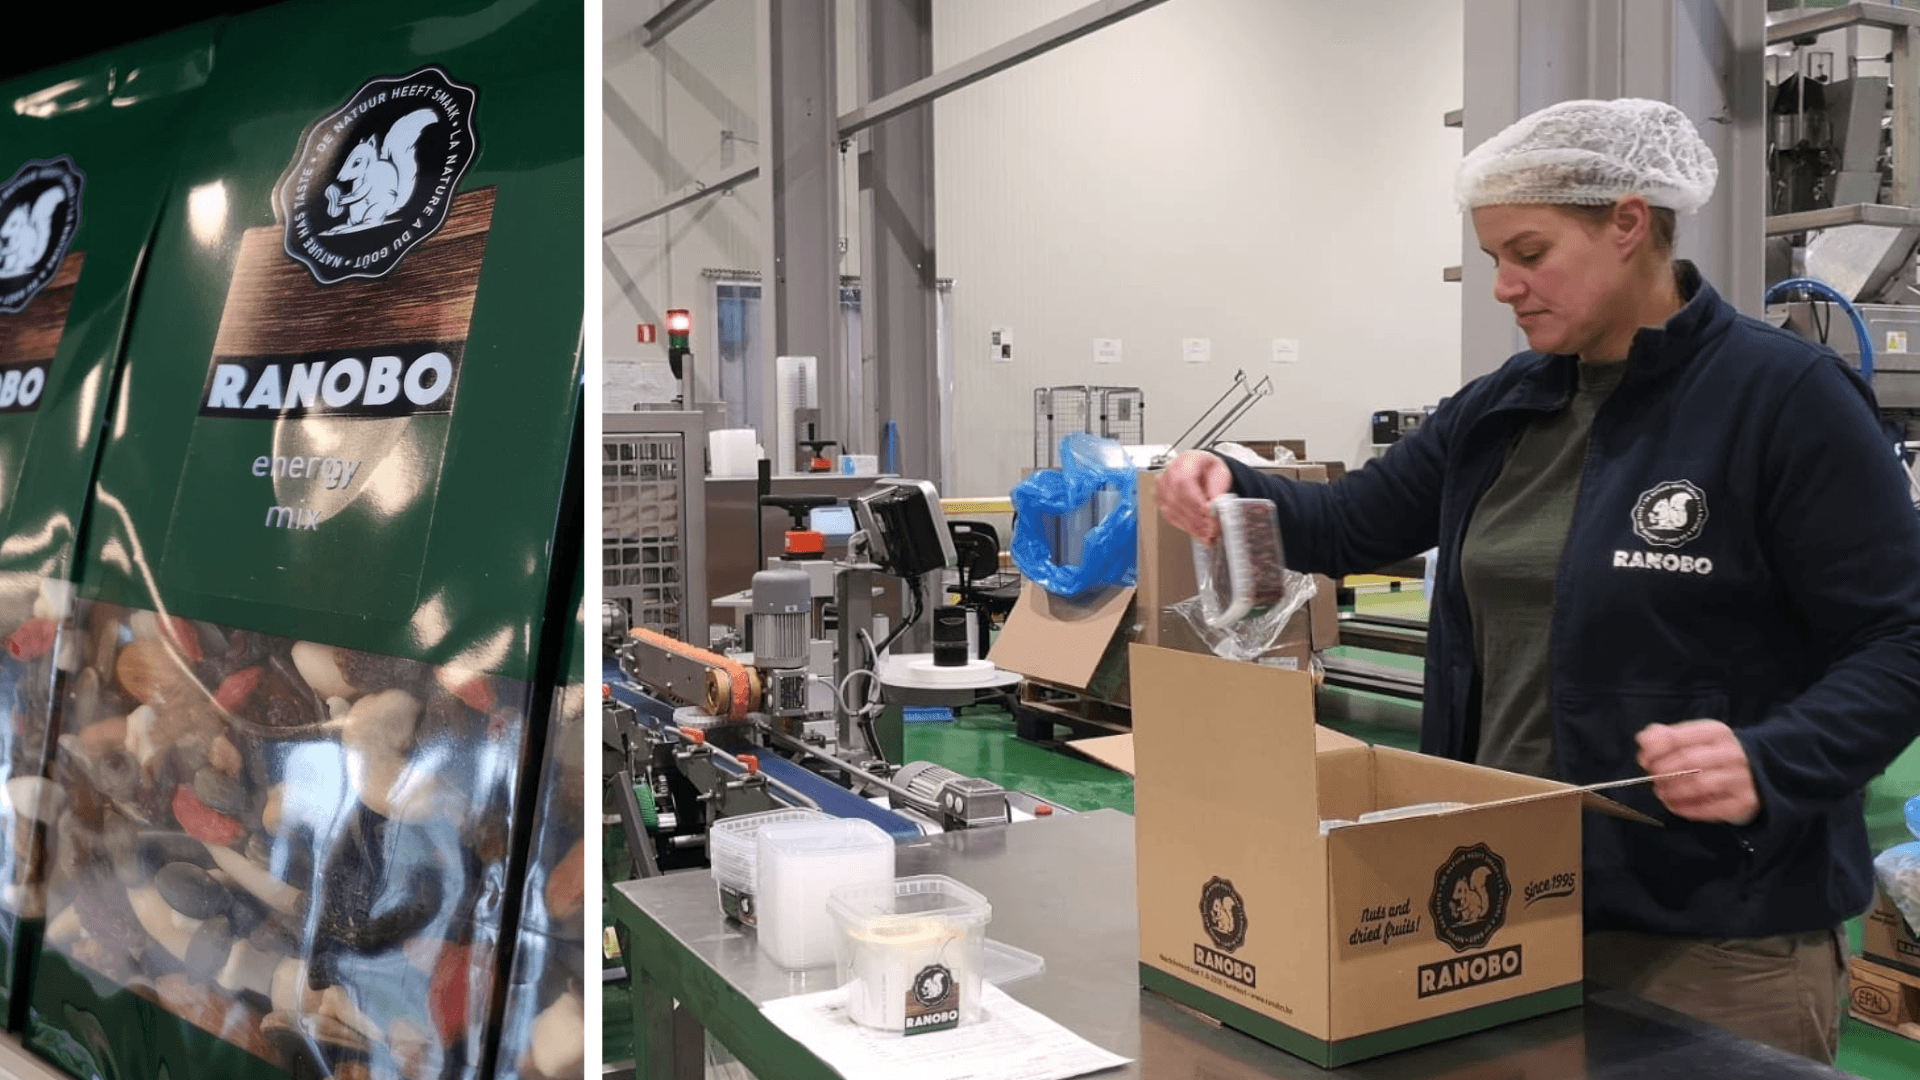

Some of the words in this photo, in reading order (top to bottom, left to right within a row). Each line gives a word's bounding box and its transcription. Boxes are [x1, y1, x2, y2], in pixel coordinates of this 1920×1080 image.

[316, 132, 334, 152] DE
[334, 93, 386, 133] NATUUR
[391, 85, 434, 100] HEEFT
[432, 89, 460, 121] SMAAK
[449, 129, 461, 150] LA
[293, 168, 314, 209] TASTE
[422, 154, 458, 217] NATURE
[294, 211, 309, 238] HAS
[393, 230, 411, 250] DU
[302, 236, 344, 268] NATURE
[353, 249, 389, 269] GOÛT
[0, 367, 45, 408] BO
[207, 352, 453, 409] RANOBO
[251, 455, 362, 490] energy
[265, 499, 323, 532] mix
[1613, 550, 1713, 575] RANOBO
[1523, 879, 1551, 901] since
[1552, 872, 1576, 889] 1995
[1361, 905, 1386, 923] Nuts
[1388, 897, 1412, 918] and
[1349, 923, 1382, 945] dried
[1383, 915, 1421, 945] fruits!
[1195, 947, 1254, 984] RANOBO
[1420, 950, 1519, 993] RANOBO
[1859, 990, 1884, 1011] EPAL
[905, 1010, 957, 1028] RANOBO
